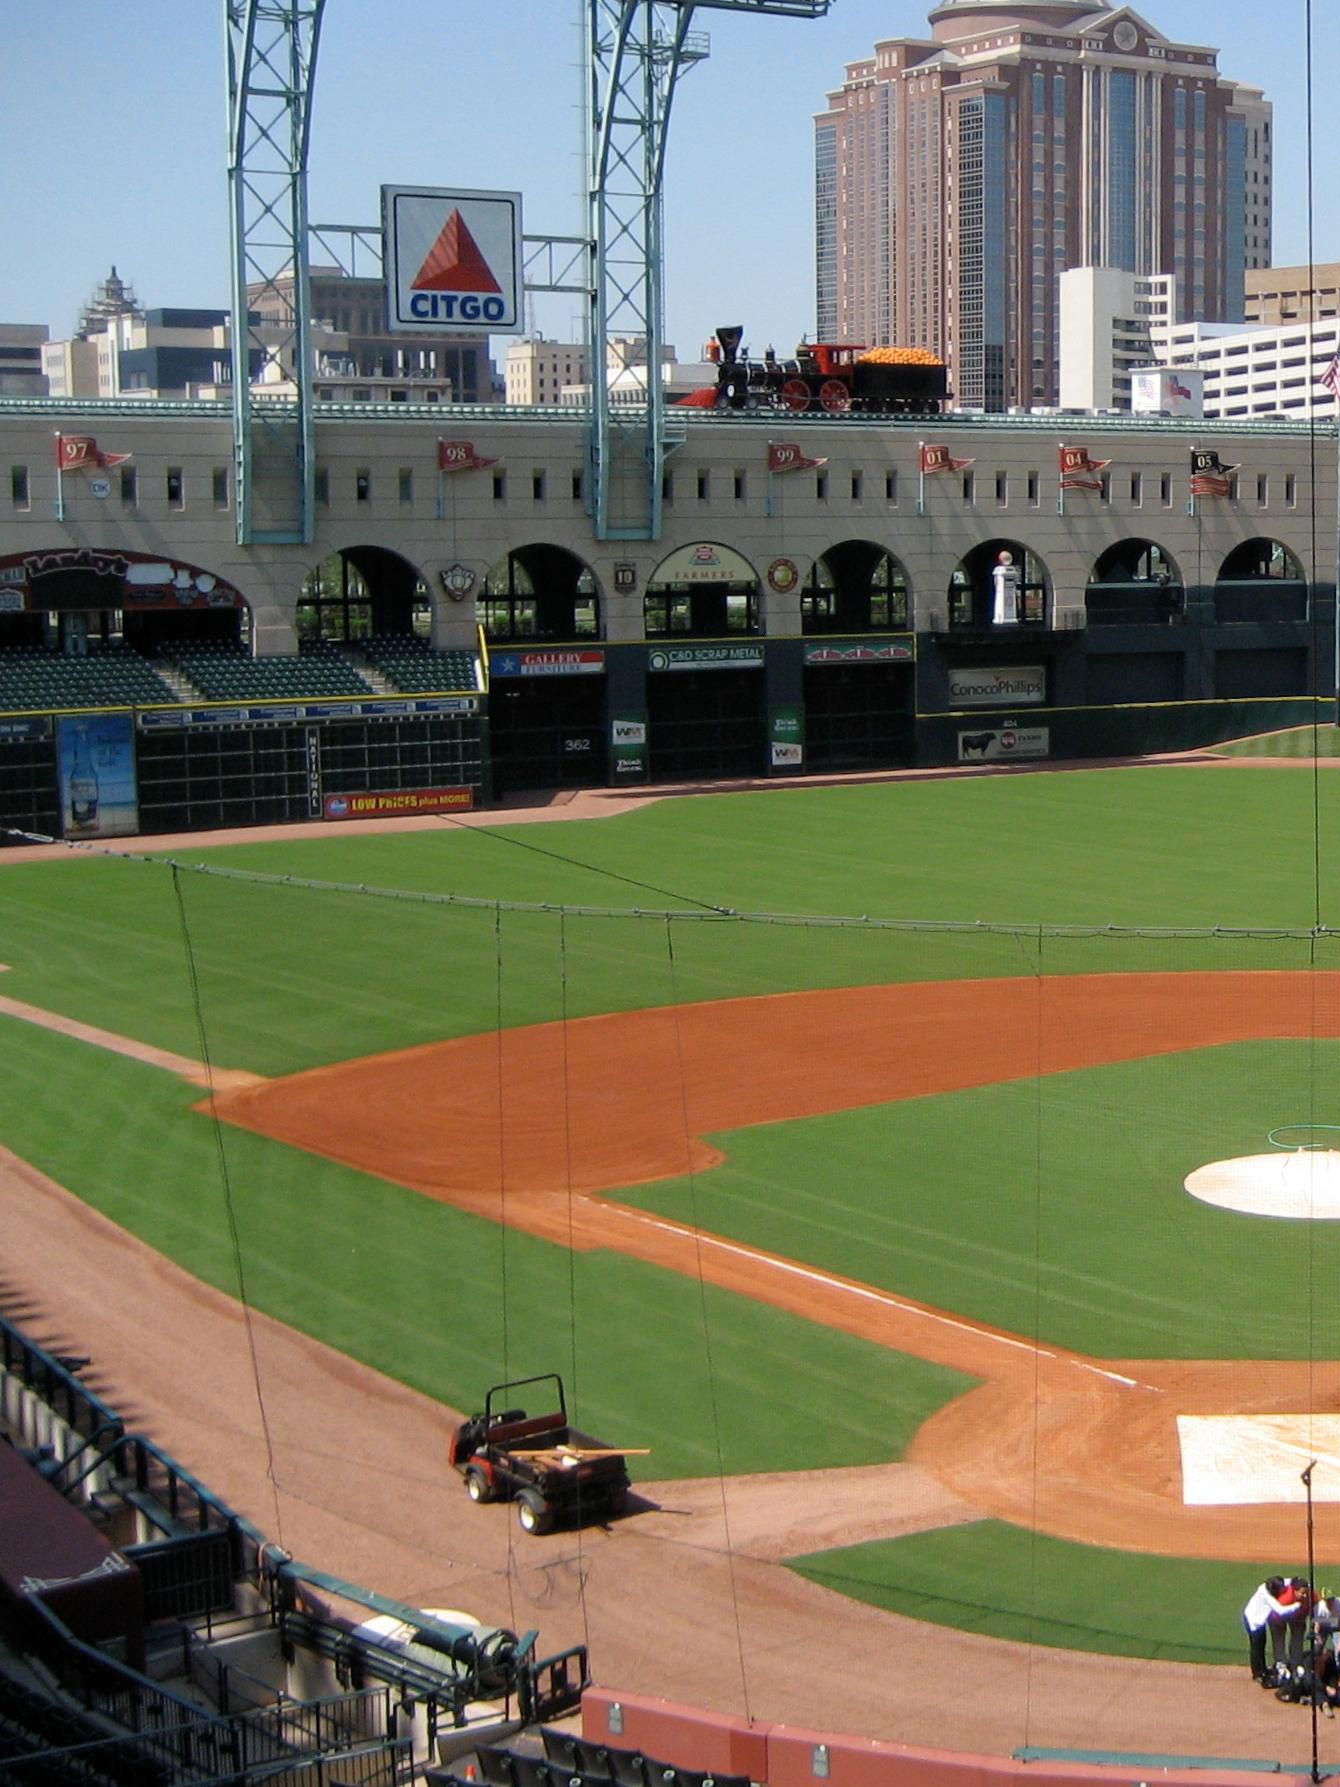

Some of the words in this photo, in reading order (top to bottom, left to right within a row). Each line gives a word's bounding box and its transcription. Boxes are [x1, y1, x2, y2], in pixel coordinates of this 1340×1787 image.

[410, 292, 505, 321] CITGO
[66, 443, 88, 459] 97
[447, 447, 466, 462] 98
[777, 450, 794, 463] 99
[926, 450, 942, 465] 01
[1066, 453, 1082, 466] 04
[1197, 456, 1212, 469] 05
[617, 570, 632, 584] 10
[675, 570, 735, 580] FARMERS
[525, 653, 582, 665] GALLERY
[694, 649, 727, 660] SCRAP
[729, 648, 761, 659] METAL
[950, 680, 1041, 697] ConocoPhillips
[565, 739, 590, 751] 362
[309, 736, 319, 808] NATIONAL
[352, 798, 377, 811] LOW
[379, 795, 417, 810] PRICES
[419, 796, 438, 807] plus
